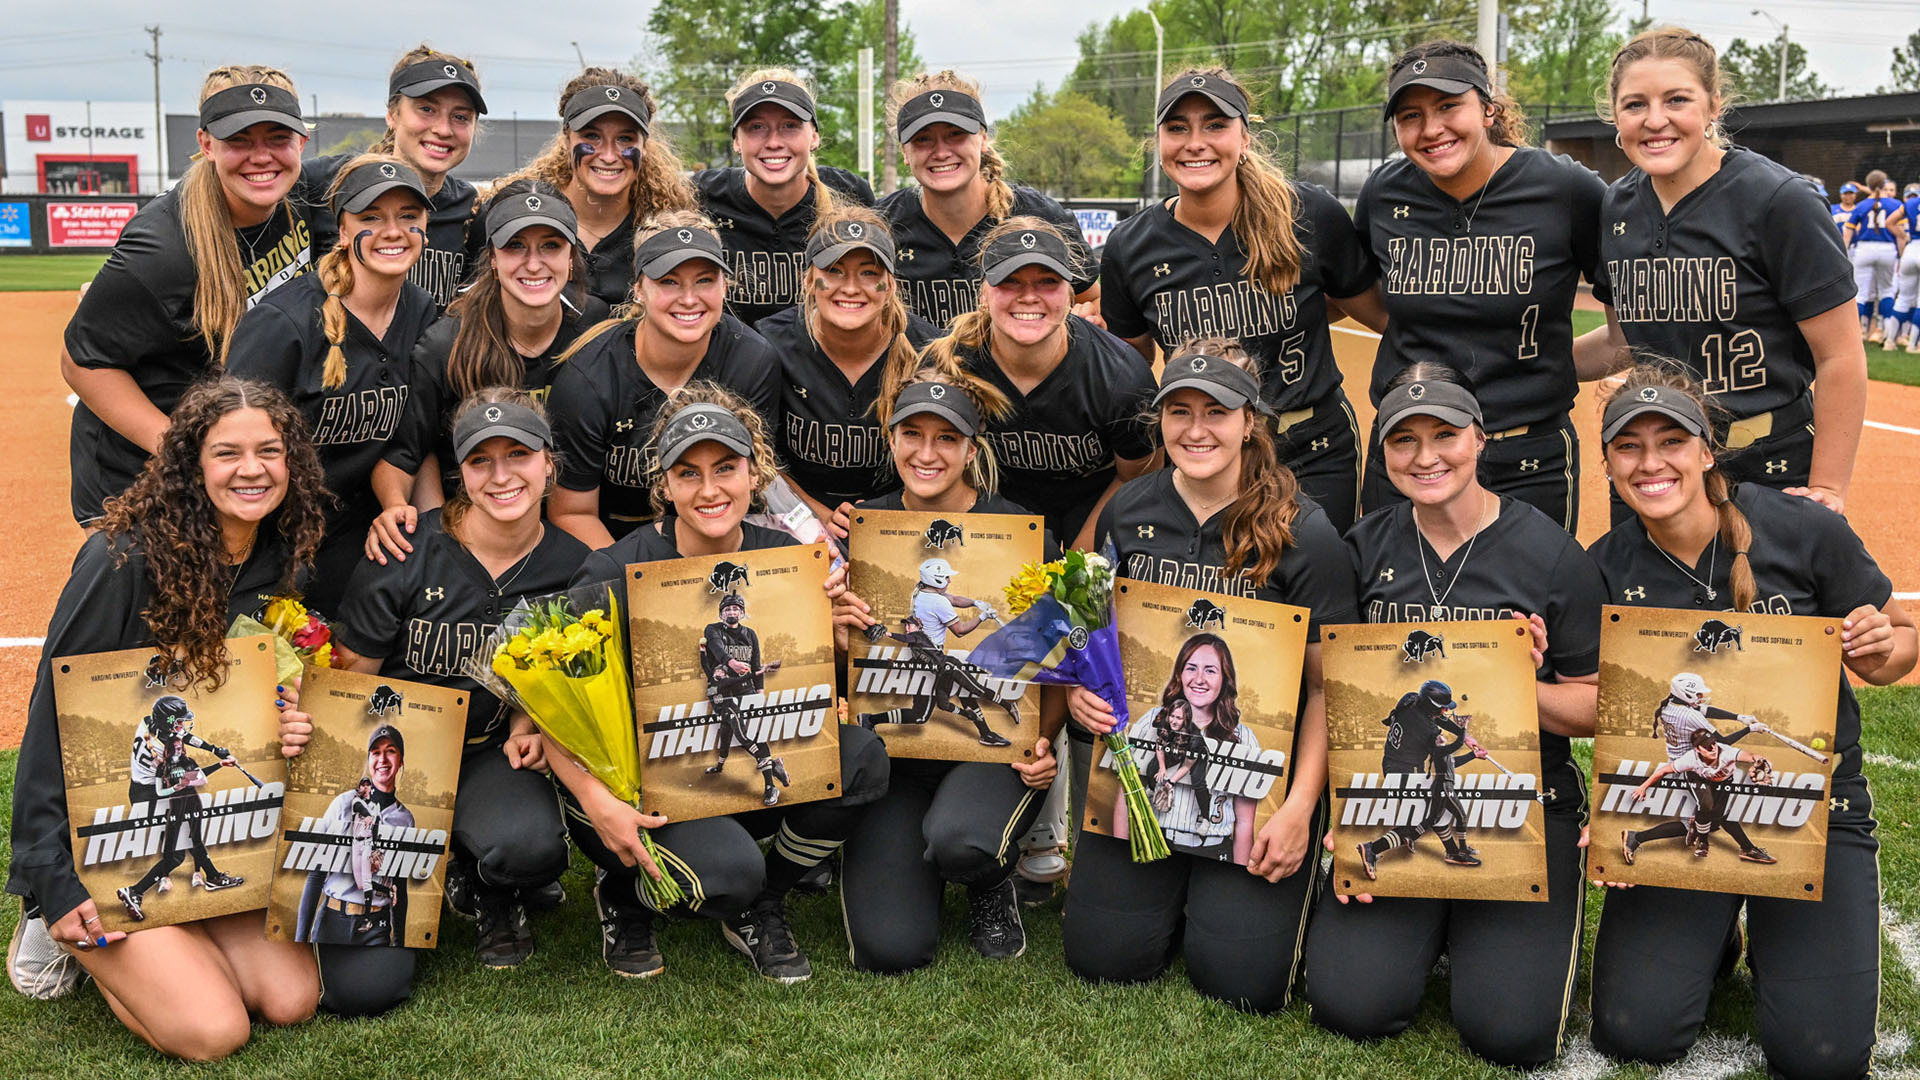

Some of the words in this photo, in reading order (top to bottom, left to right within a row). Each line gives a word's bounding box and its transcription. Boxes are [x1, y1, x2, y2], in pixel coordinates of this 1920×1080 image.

[56, 127, 145, 139] STORAGE
[243, 220, 310, 297] ARDING
[1388, 235, 1536, 295] HARDING
[1155, 279, 1298, 347] HARDING
[1608, 257, 1737, 323] HARDING
[1279, 330, 1305, 386] 5
[1518, 304, 1540, 360] 1
[1702, 328, 1767, 395] 12
[787, 411, 881, 469] HARDI
[1638, 629, 1660, 638] HARDING
[1661, 630, 1688, 639] UNIVERSITY
[1751, 635, 1769, 644] BISONS
[1770, 637, 1793, 645] SOFTBALL
[892, 662, 938, 670] HANNAH
[675, 714, 723, 728] MAEGAN
[730, 704, 803, 720] PISTOKACHE
[1136, 740, 1179, 754] PAYTON
[1186, 751, 1246, 768] REYNOLDS
[1340, 772, 1537, 829] HARING
[1387, 790, 1433, 798] NICOLE
[1440, 790, 1482, 798] SHANO
[1600, 759, 1826, 828] HAING
[1661, 779, 1708, 790] HANNA
[1716, 784, 1760, 795] JONES
[134, 814, 177, 828] SARAH
[185, 806, 234, 820] HUDLER
[283, 816, 448, 881] HARING
